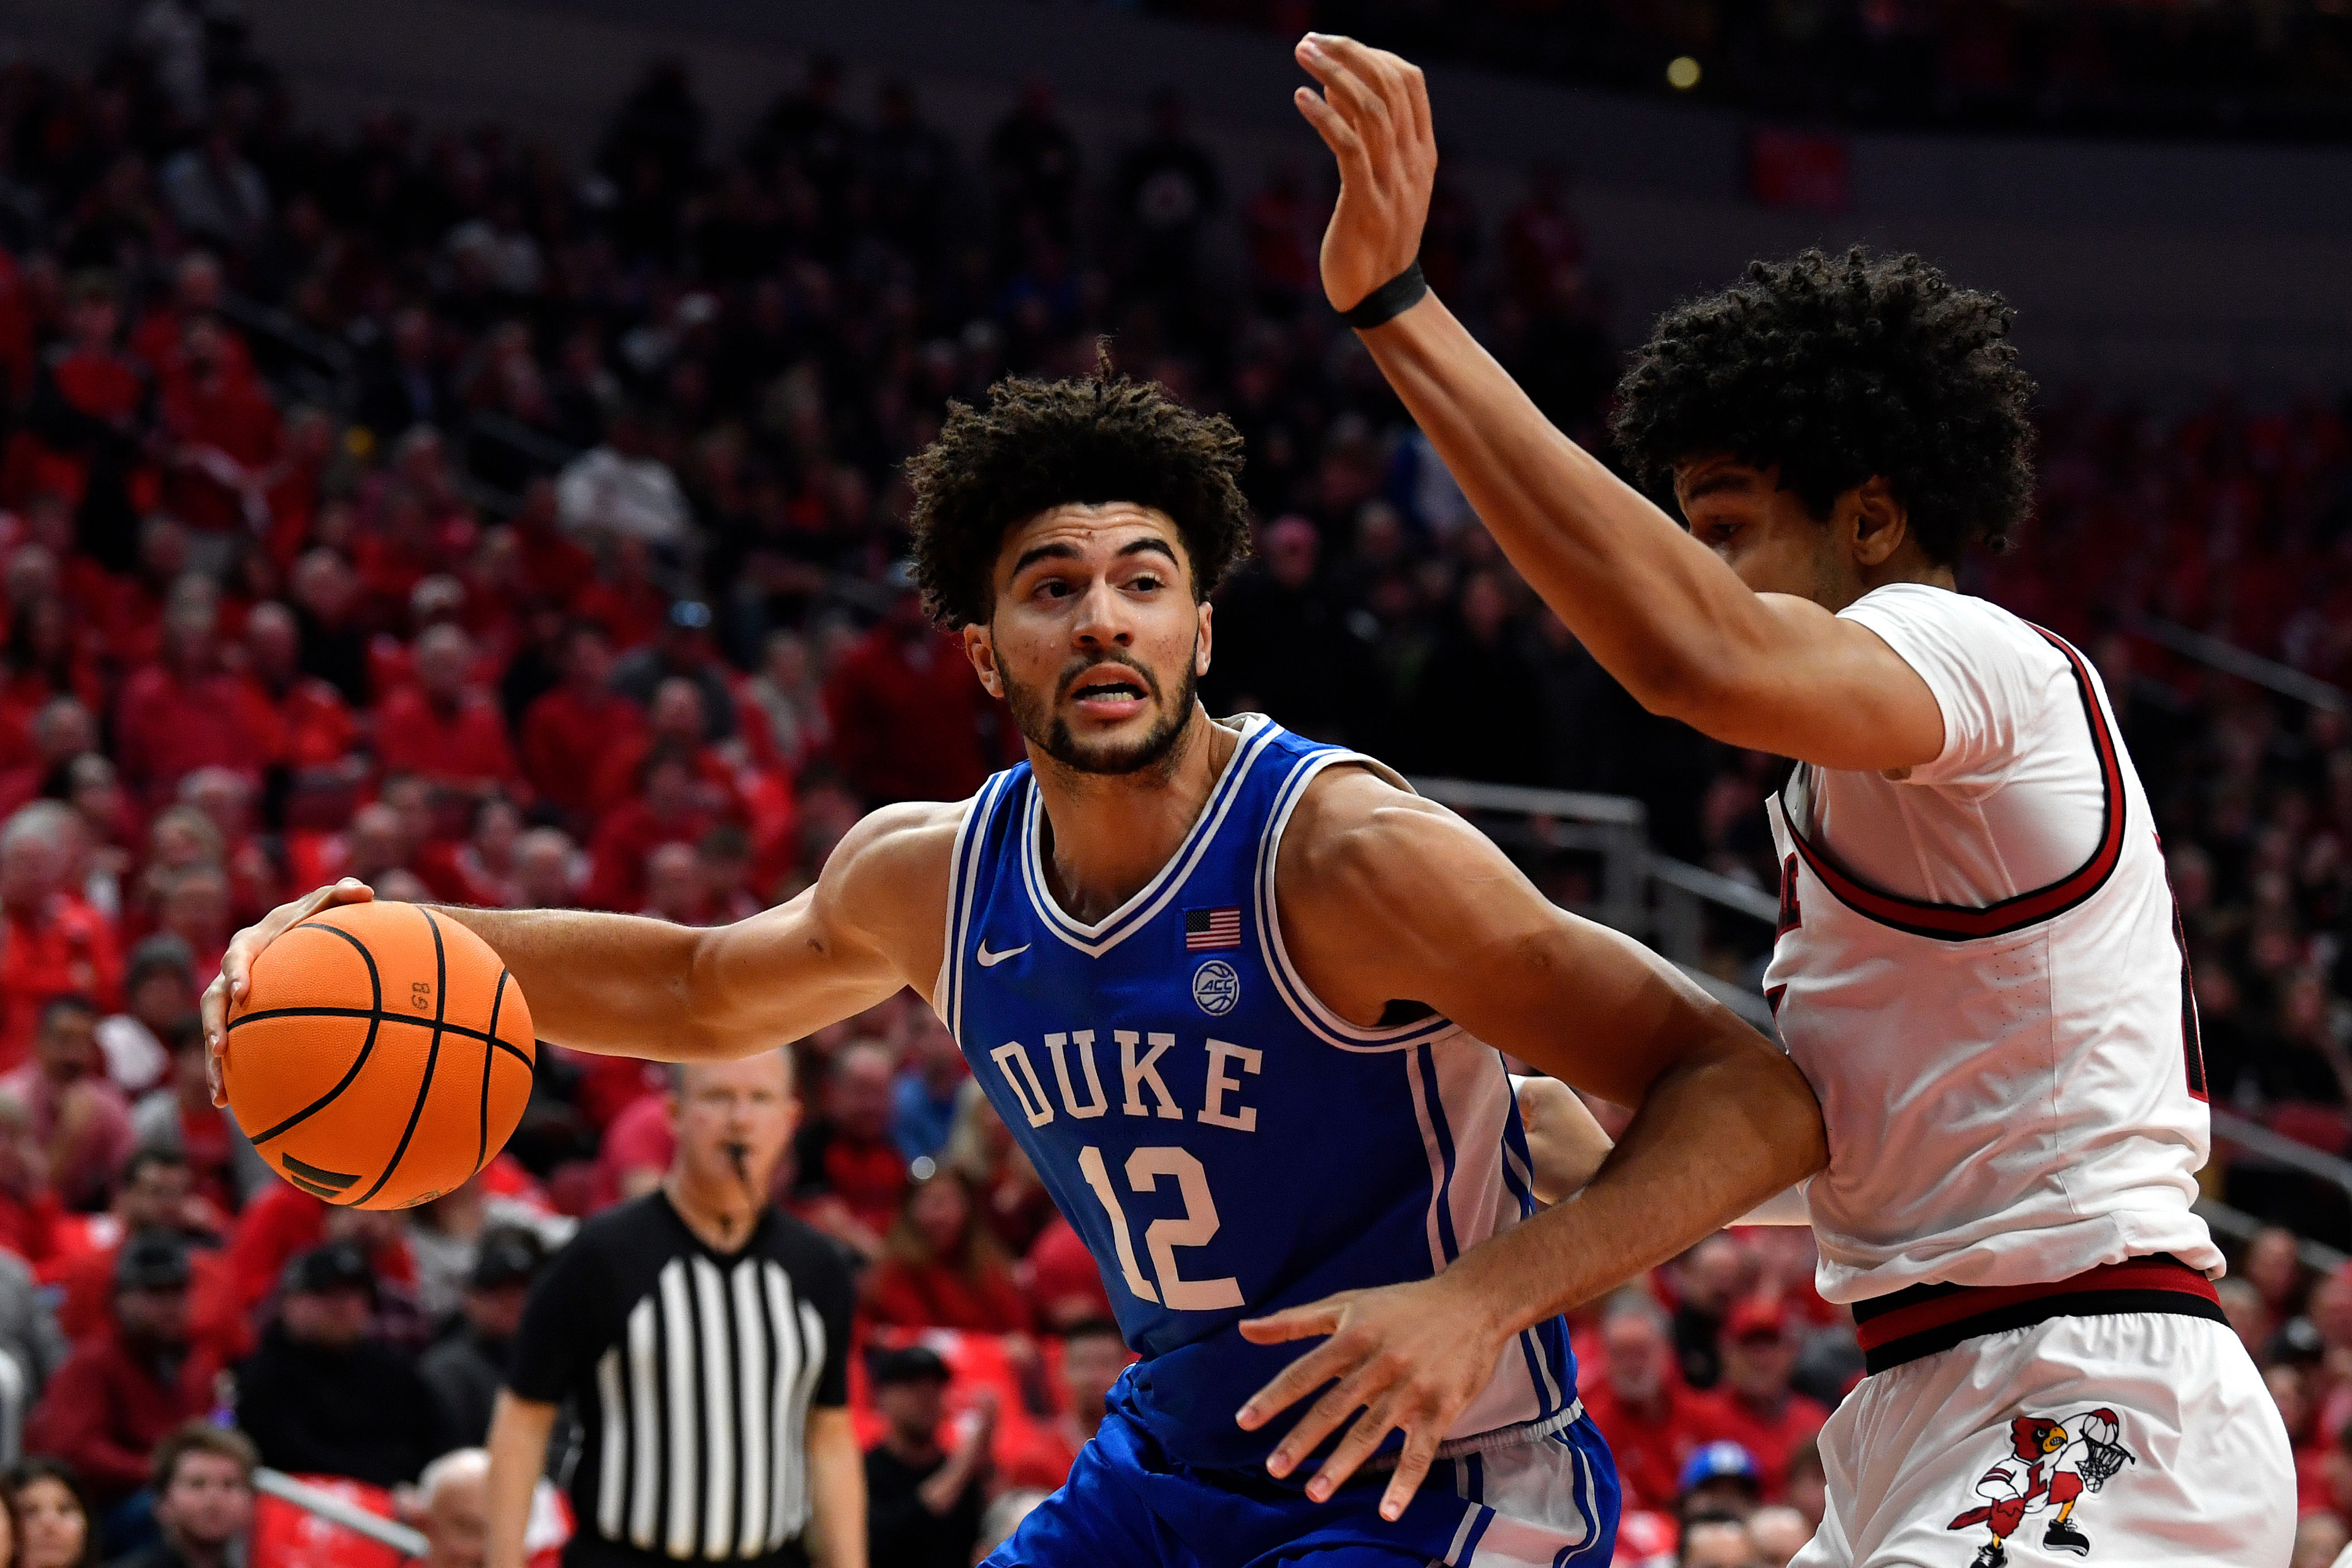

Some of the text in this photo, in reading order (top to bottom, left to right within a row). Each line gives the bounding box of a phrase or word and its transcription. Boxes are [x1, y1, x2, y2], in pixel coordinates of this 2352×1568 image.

[1201, 979, 1234, 991] ACC
[990, 1029, 1263, 1132] DUKE
[1078, 1145, 1245, 1310] 12
